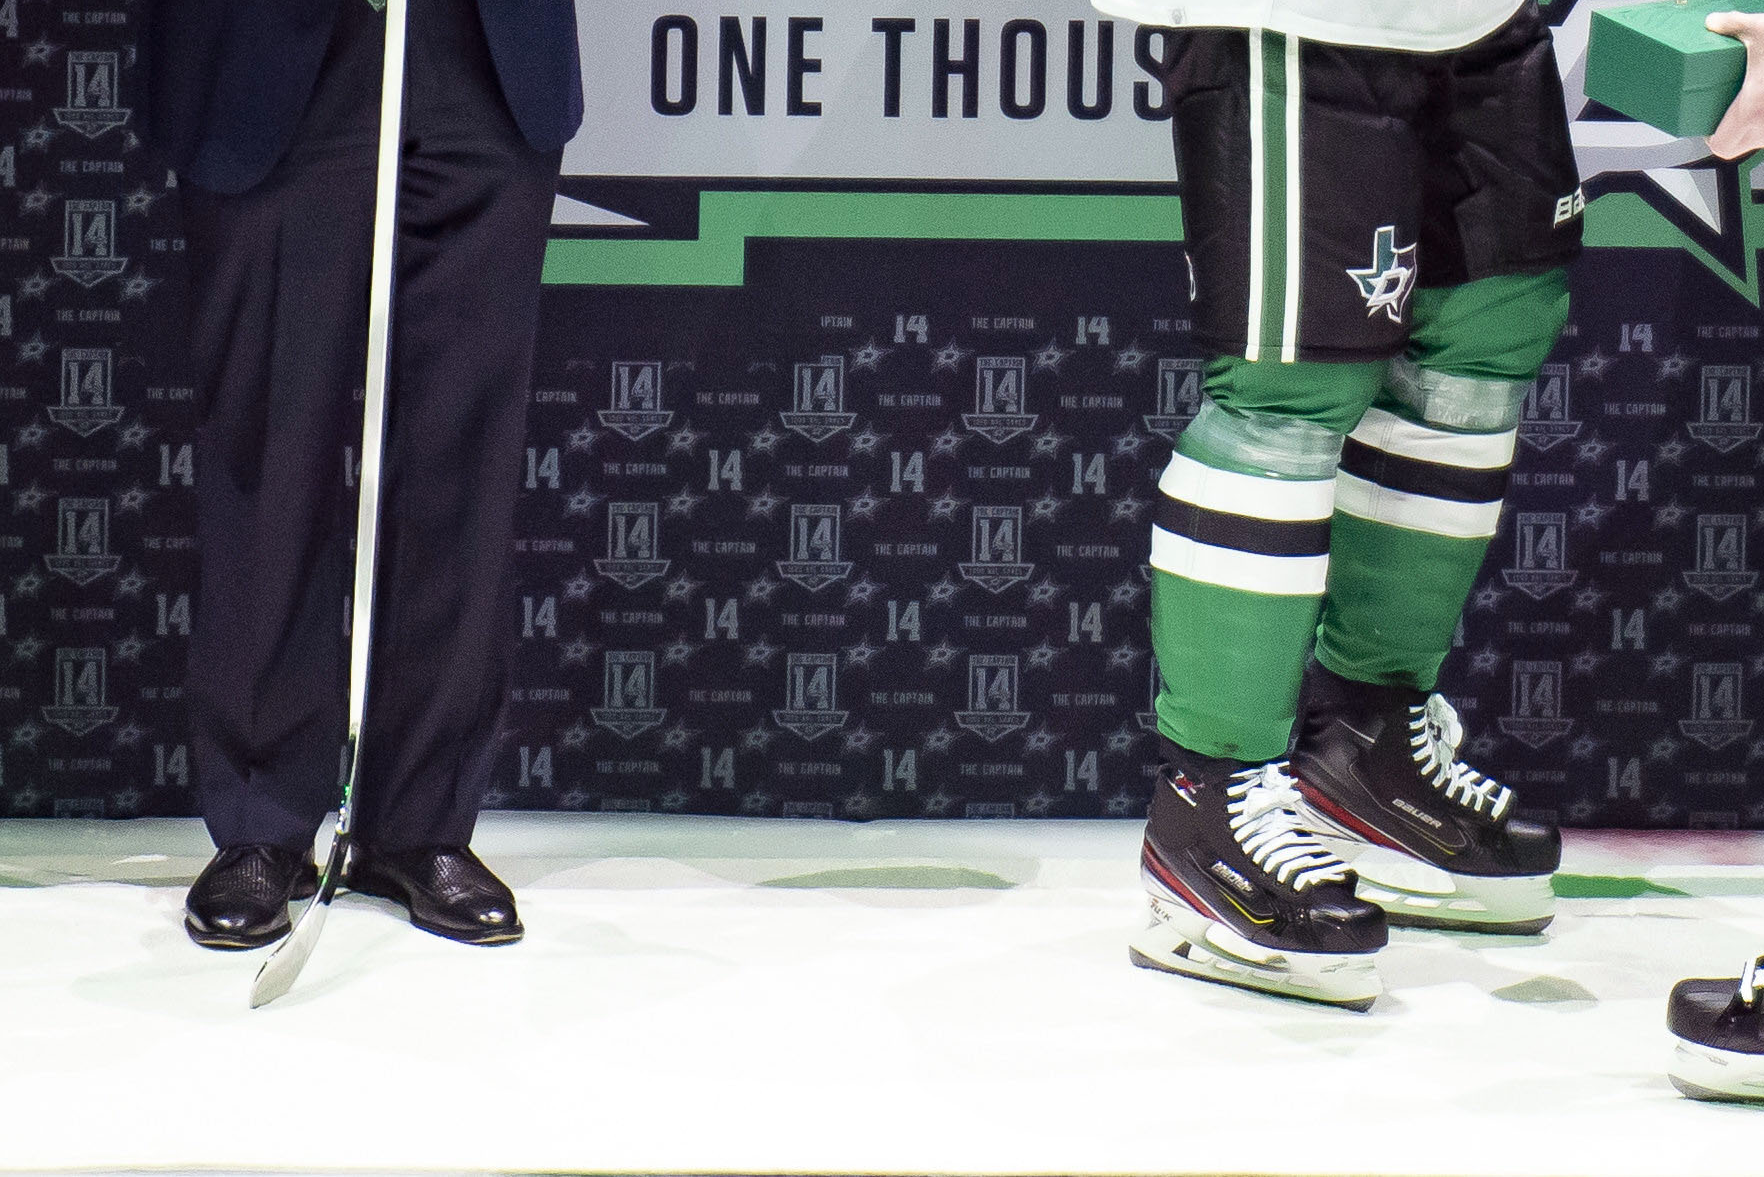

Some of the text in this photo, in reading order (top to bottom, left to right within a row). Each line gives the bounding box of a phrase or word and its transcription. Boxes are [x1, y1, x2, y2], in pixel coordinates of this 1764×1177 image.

[650, 13, 824, 118] ONE
[871, 16, 1172, 121] THOUS
[72, 213, 106, 254] 14
[983, 370, 1017, 411] 14
[1708, 379, 1742, 420] 14
[159, 444, 194, 486] 14
[525, 448, 560, 490] 14
[708, 450, 743, 492] 14
[890, 452, 925, 494] 14
[1072, 453, 1107, 495] 14
[1615, 460, 1650, 502] 14
[66, 511, 100, 552] 14
[797, 517, 831, 558] 14
[979, 519, 1013, 560] 14
[1523, 526, 1557, 567] 14
[1704, 527, 1738, 568] 14
[156, 594, 191, 636] 14
[522, 596, 557, 638] 14
[704, 598, 739, 640] 14
[886, 600, 921, 642] 14
[1068, 602, 1103, 644] 14
[1611, 609, 1646, 651] 14
[154, 744, 189, 786] 14
[518, 746, 553, 788] 14
[700, 747, 735, 789] 14
[883, 749, 918, 791] 14
[1064, 750, 1099, 792] 14
[1607, 757, 1642, 799] 14
[1391, 797, 1442, 829] BAUER
